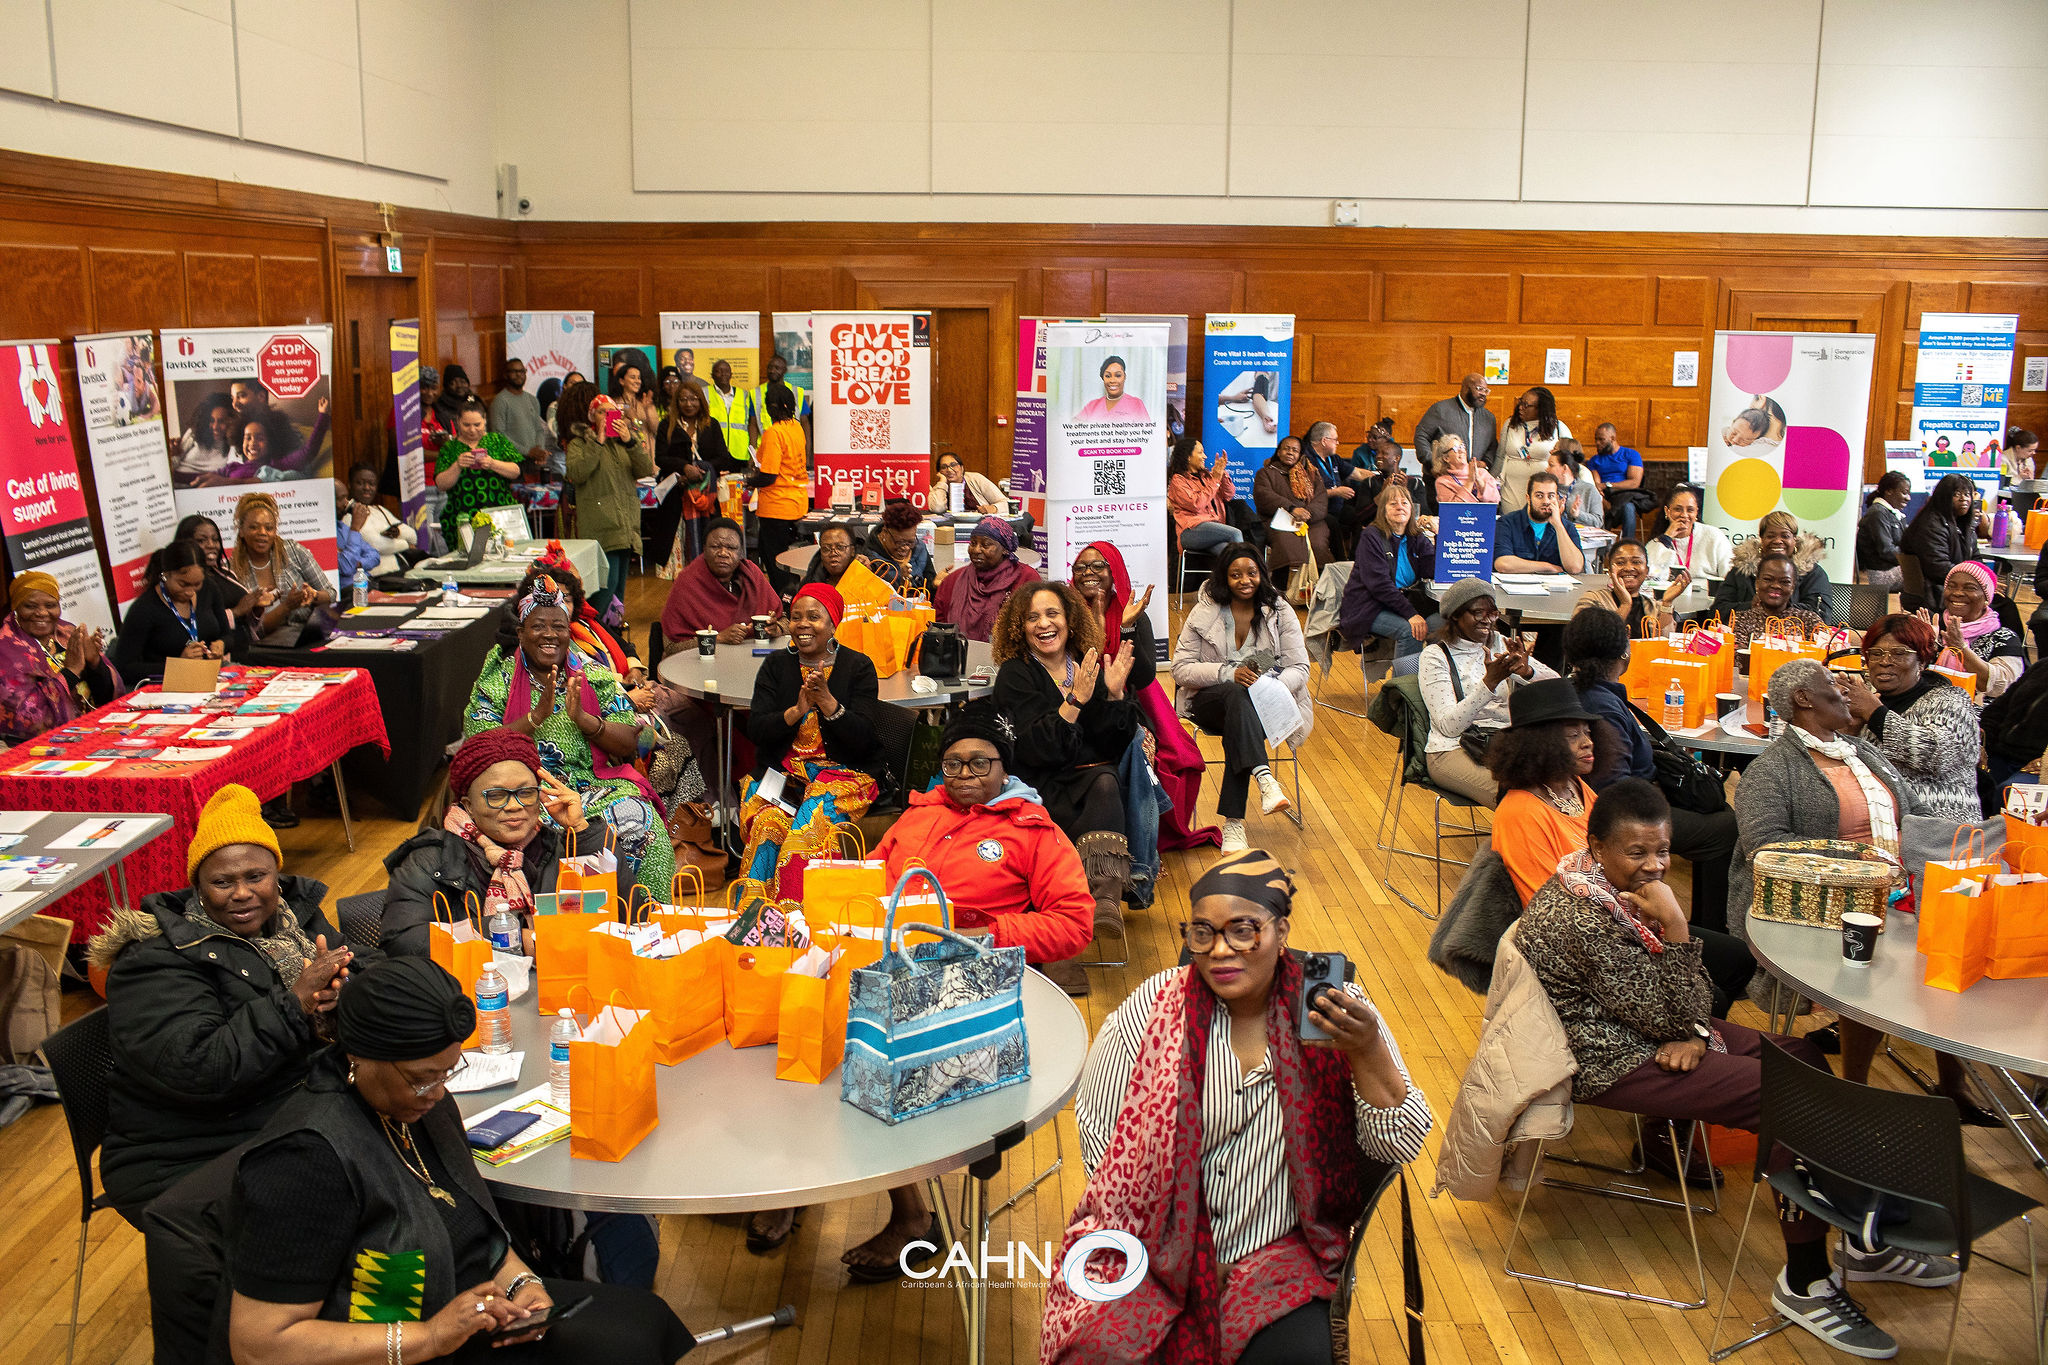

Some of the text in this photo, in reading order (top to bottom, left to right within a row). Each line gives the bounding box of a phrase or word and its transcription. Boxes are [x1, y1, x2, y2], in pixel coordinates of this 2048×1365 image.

[672, 321, 748, 331] PrEP&Prejudice
[830, 324, 909, 348] GIVE
[271, 344, 306, 356] STOP!
[831, 349, 910, 367] BLOOD
[286, 368, 304, 376] your
[831, 366, 910, 381] SPREAD
[271, 376, 309, 384] insurance
[280, 384, 301, 393] today
[831, 383, 910, 404] LOVE
[1984, 393, 2003, 402] ME
[1923, 421, 1953, 429] Hepatitis
[817, 464, 920, 490] Register
[7, 470, 79, 499] Cost of living
[218, 496, 224, 504] If
[901, 489, 926, 509] to
[12, 496, 57, 524] support
[196, 509, 226, 517] Arrange
[294, 500, 318, 508] review
[1072, 502, 1148, 513] OUR SERVICES
